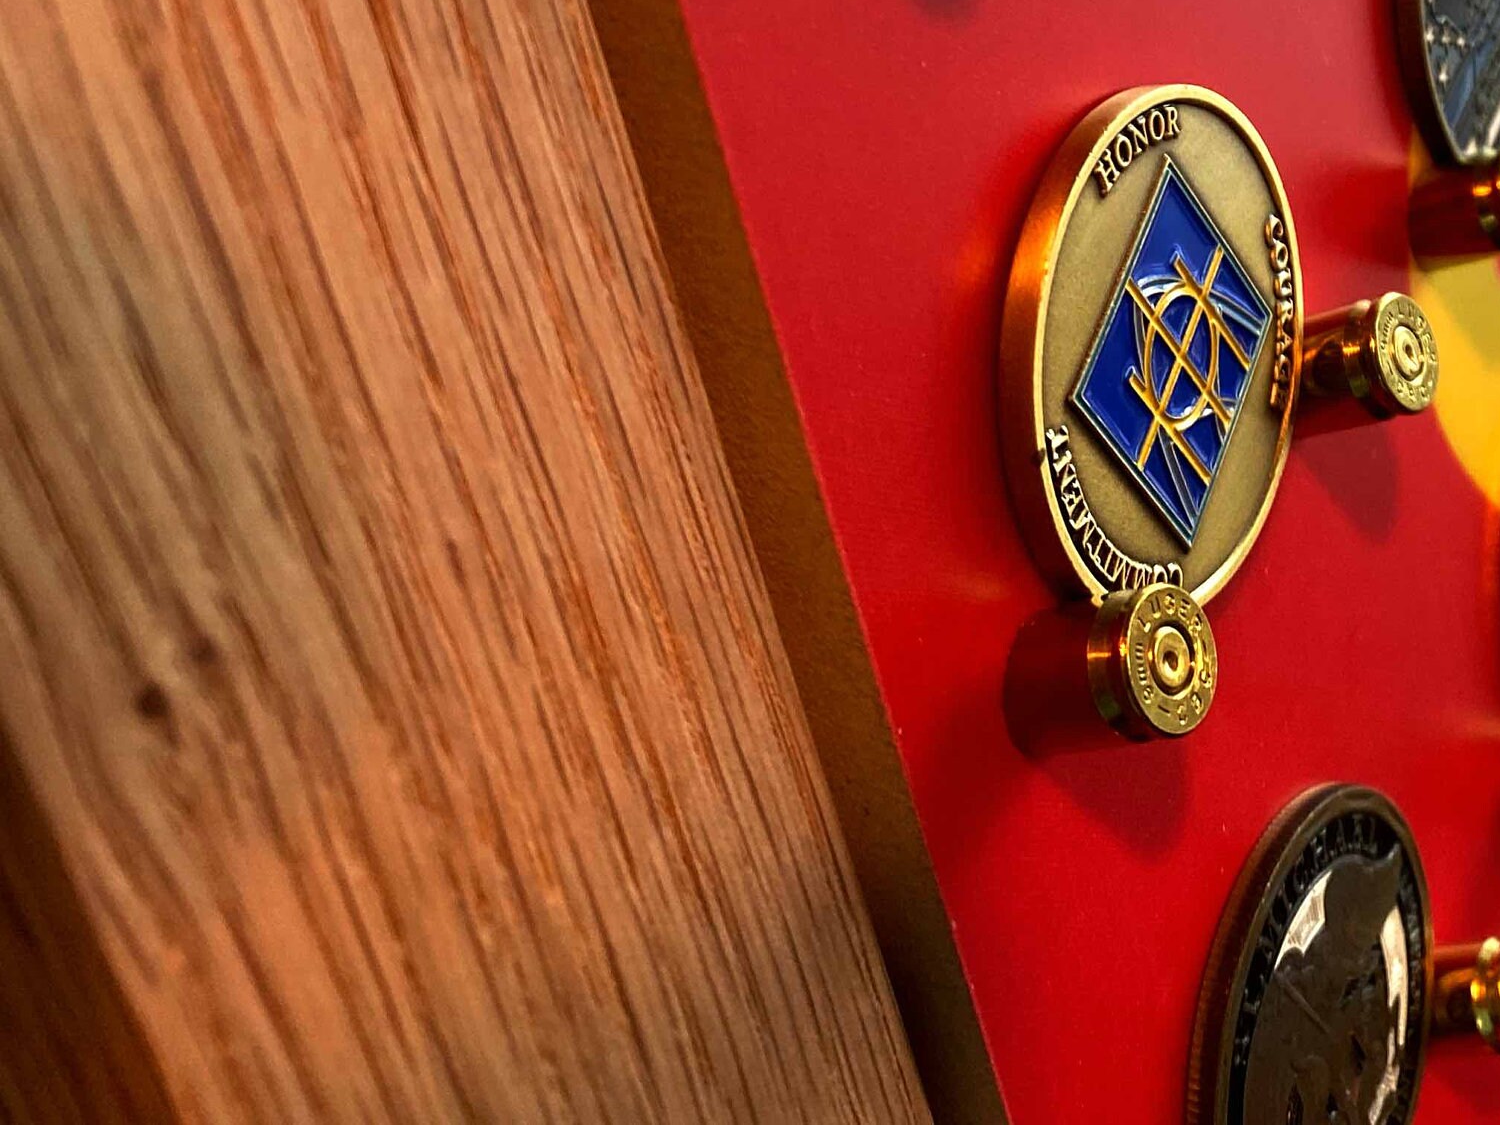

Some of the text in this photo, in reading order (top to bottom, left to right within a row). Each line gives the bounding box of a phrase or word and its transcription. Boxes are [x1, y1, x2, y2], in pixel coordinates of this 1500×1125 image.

[1094, 104, 1182, 193] HONOR
[1263, 214, 1294, 411] COURAGE
[1046, 425, 1184, 592] COMMITMENT
[1137, 592, 1203, 636] LUGER
